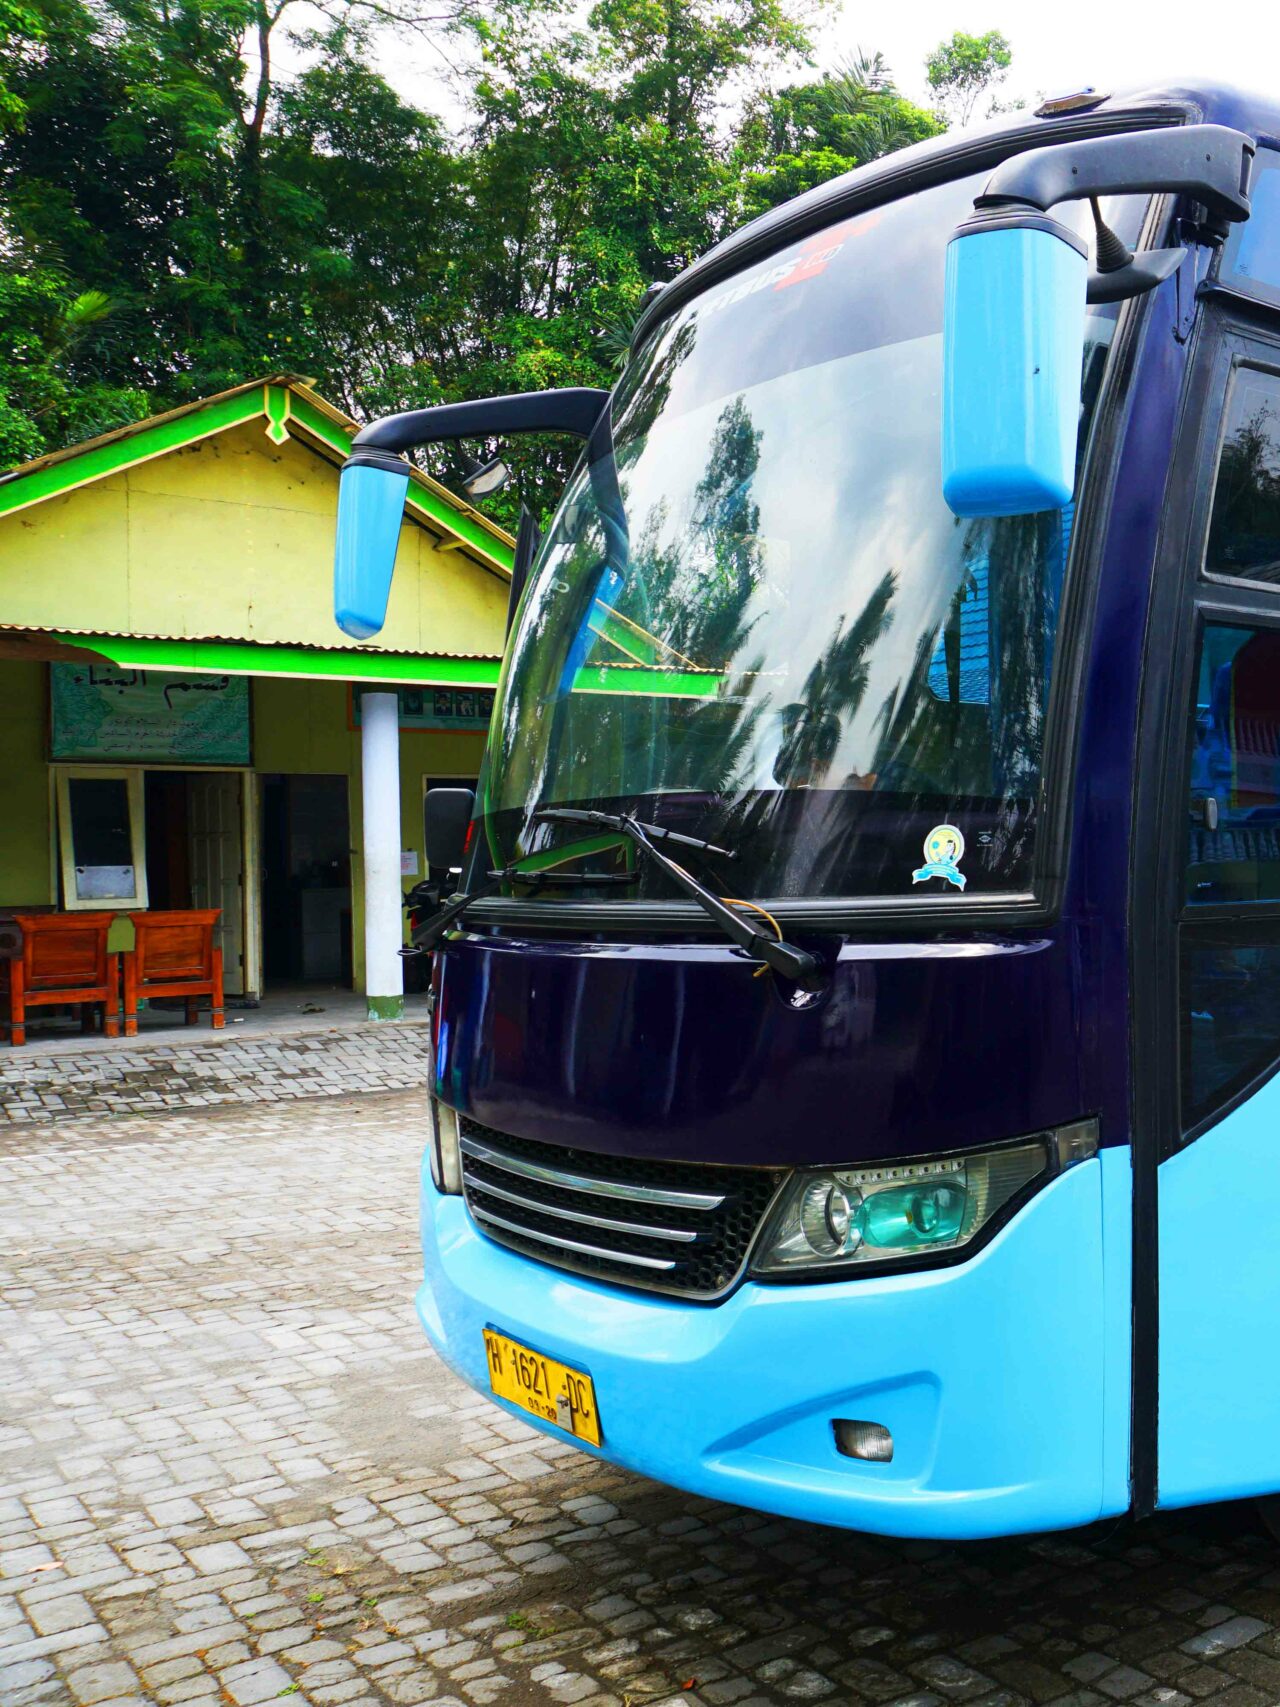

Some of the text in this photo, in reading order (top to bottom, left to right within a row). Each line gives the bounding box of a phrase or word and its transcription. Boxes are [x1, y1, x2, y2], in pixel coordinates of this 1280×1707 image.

[490, 1337, 590, 1418] H 1621 DC
